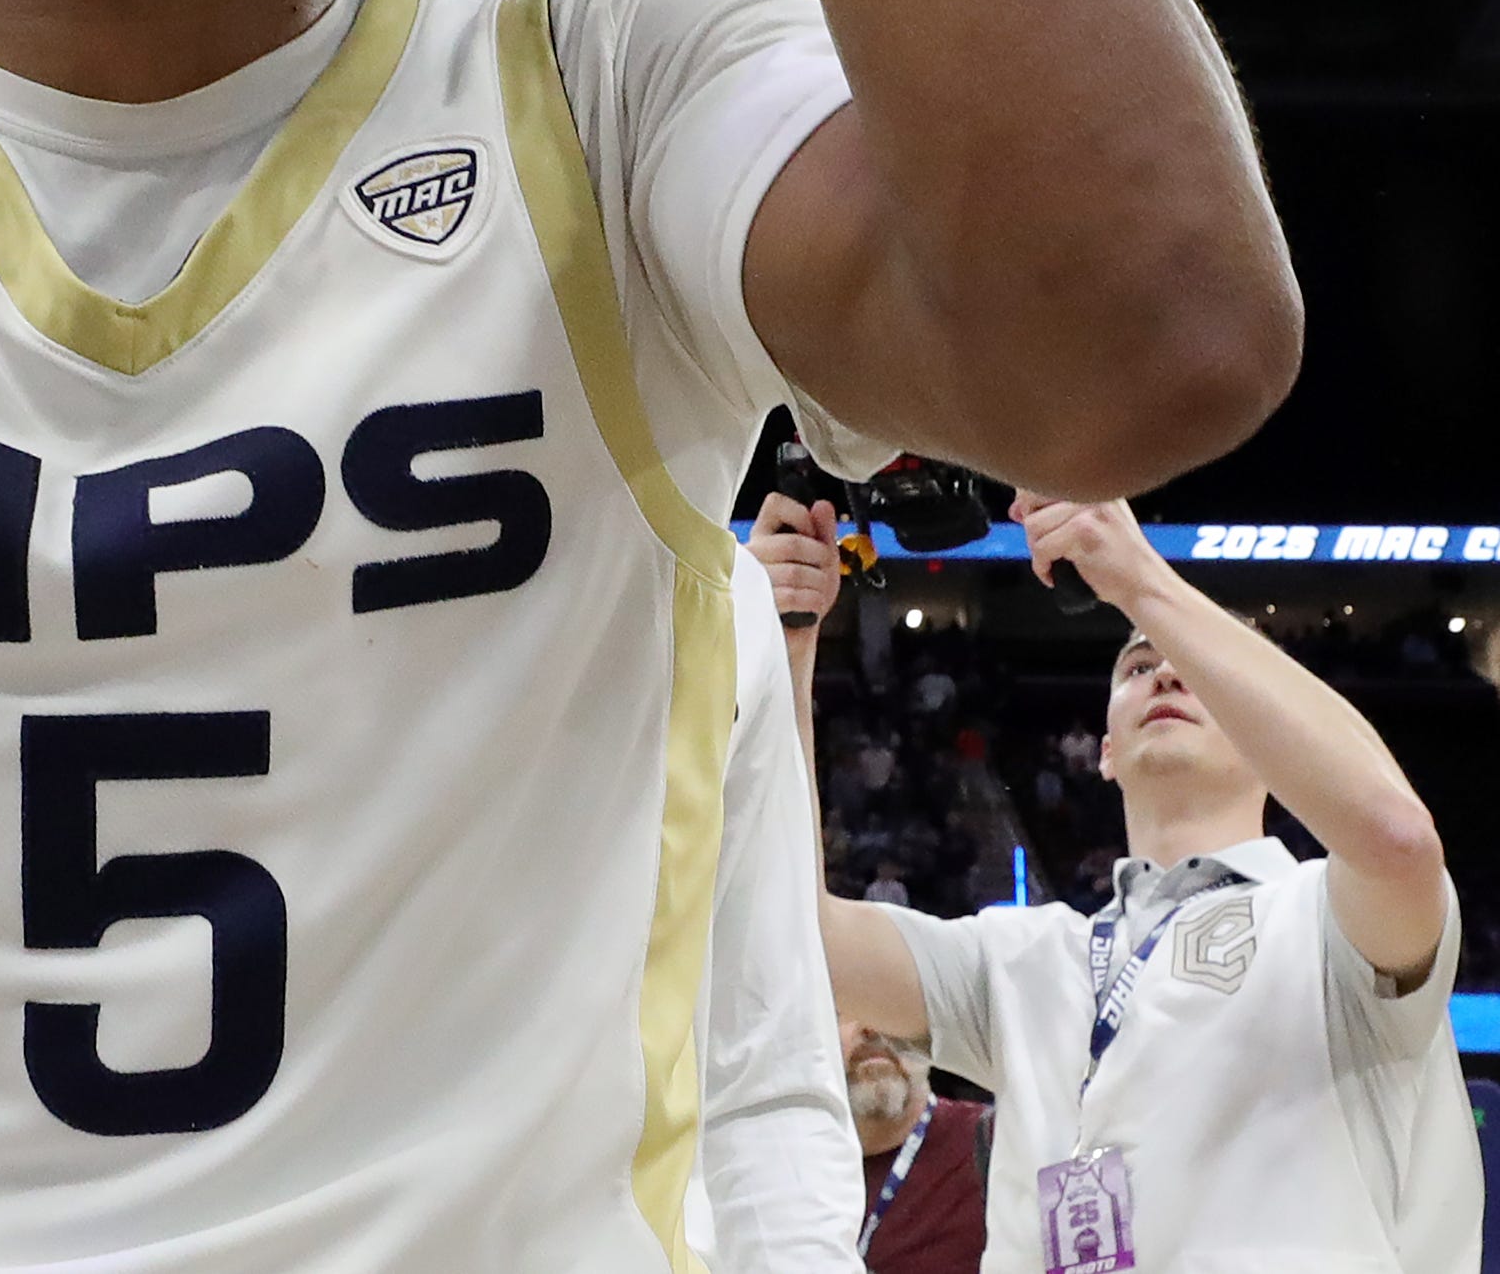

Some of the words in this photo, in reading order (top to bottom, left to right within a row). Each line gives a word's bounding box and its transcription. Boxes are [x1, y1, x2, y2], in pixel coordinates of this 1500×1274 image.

[373, 170, 475, 219] MAC
[1191, 525, 1320, 560] 2025
[1332, 526, 1450, 560] MAC
[1462, 526, 1500, 561] C
[20, 710, 288, 1137] 5
